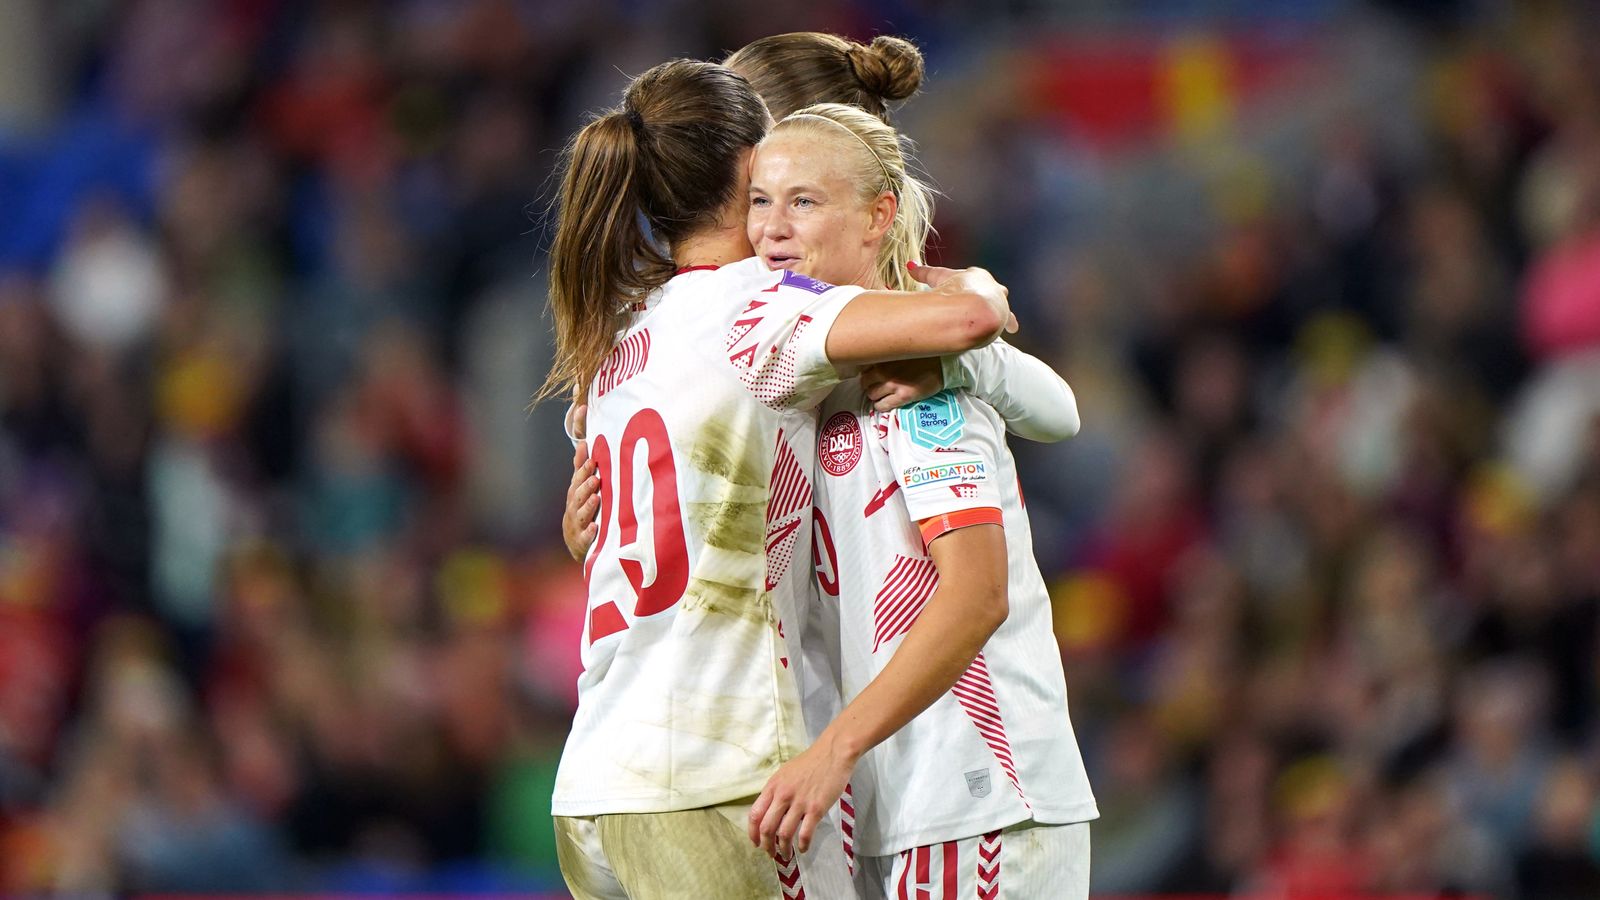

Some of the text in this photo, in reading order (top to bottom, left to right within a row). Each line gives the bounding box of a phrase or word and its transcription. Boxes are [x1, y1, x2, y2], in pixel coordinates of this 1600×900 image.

[918, 404, 931, 412] We
[920, 412, 938, 421] Play
[920, 418, 948, 427] Strong
[828, 433, 854, 453] DBU
[904, 464, 985, 486] FOUNDATION
